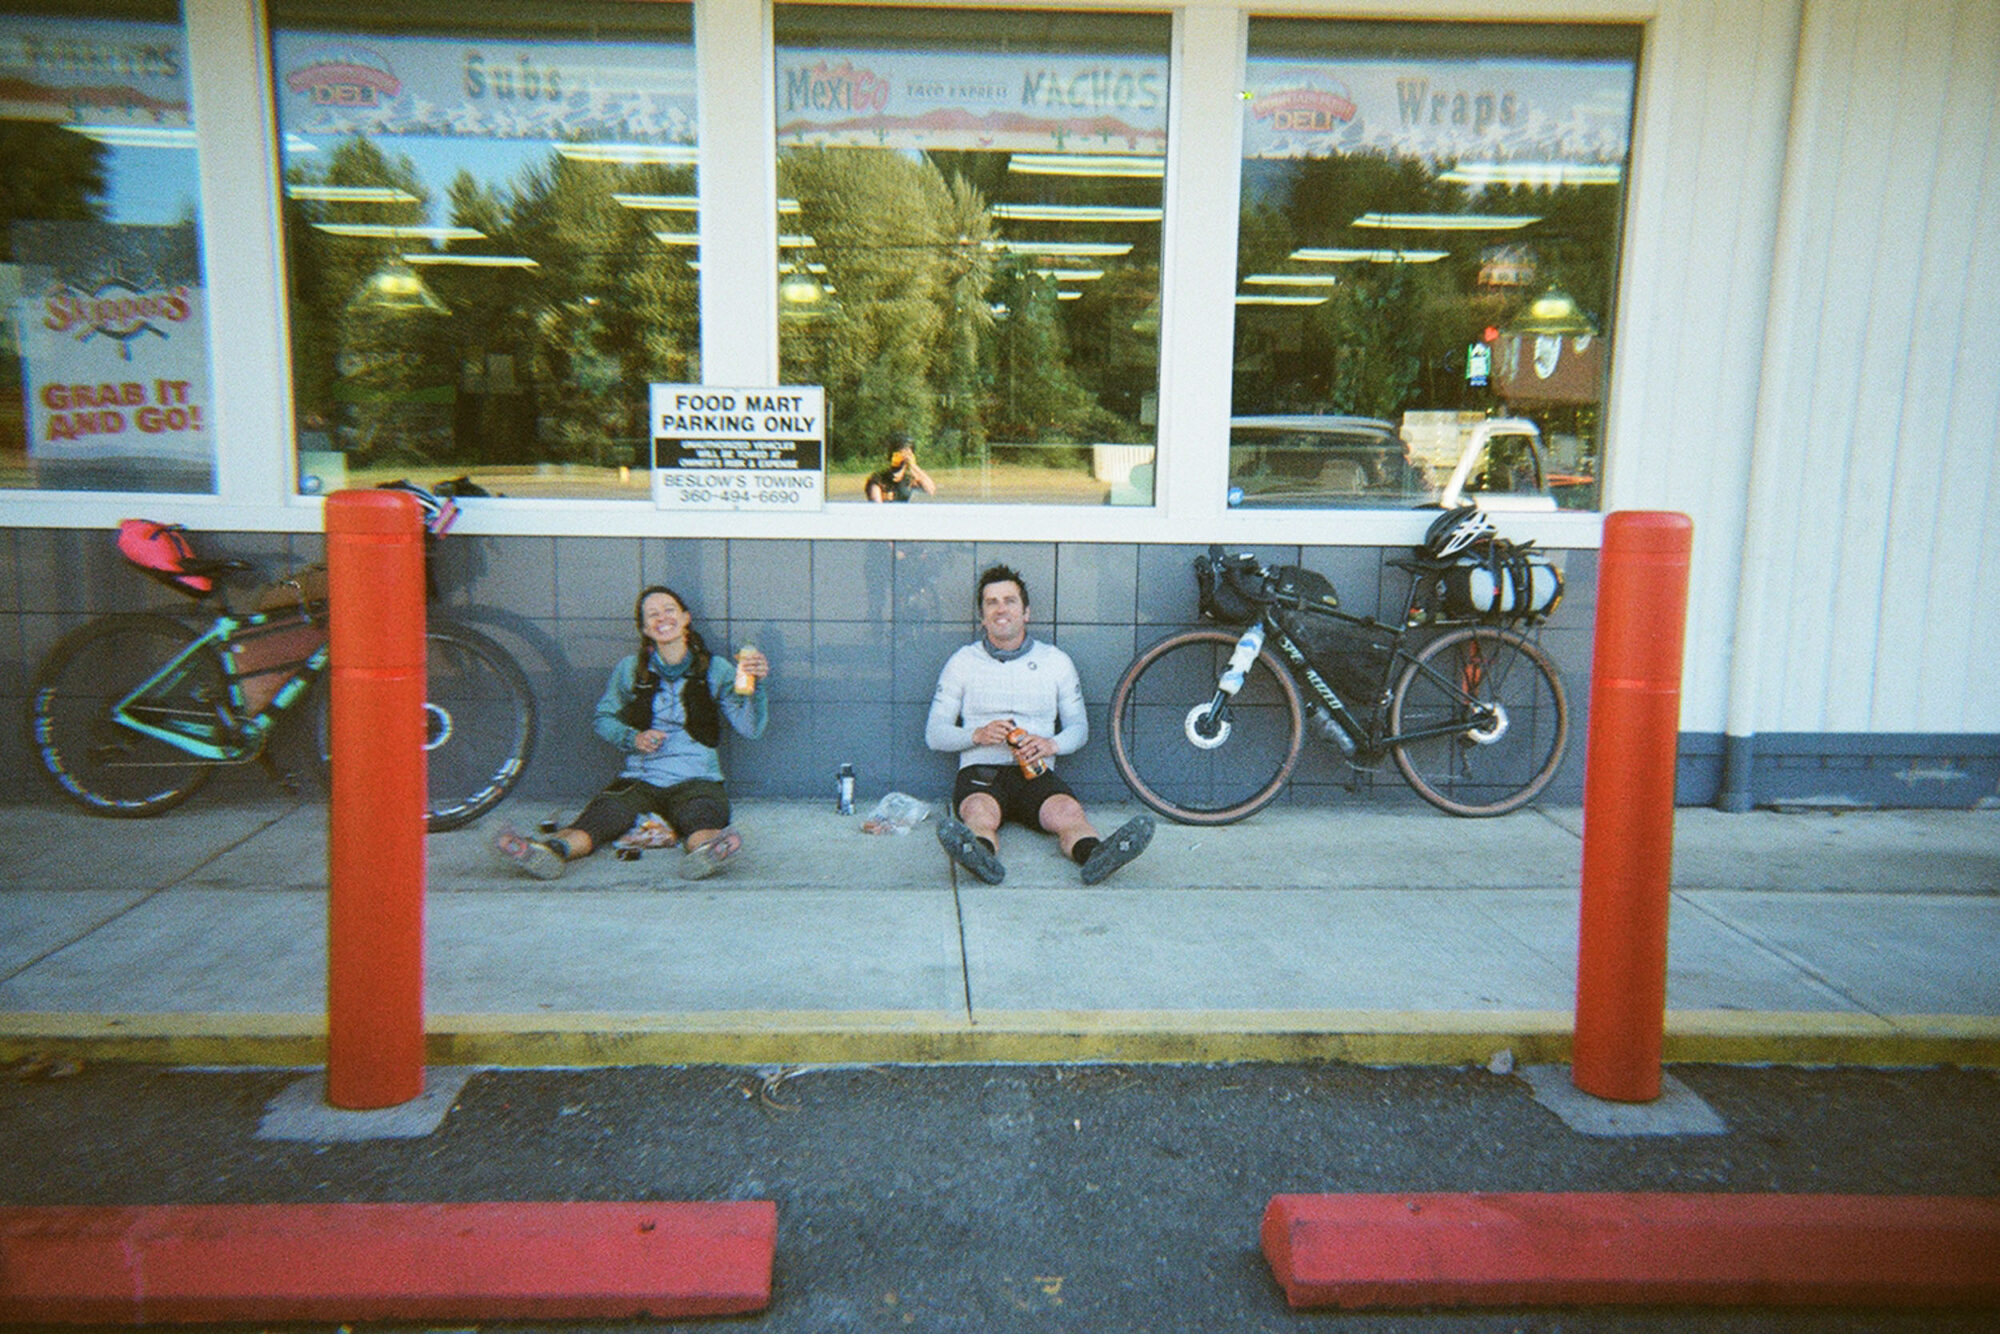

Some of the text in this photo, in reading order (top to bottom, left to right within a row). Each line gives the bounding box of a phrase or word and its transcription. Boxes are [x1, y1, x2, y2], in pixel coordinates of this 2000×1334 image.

[464, 48, 562, 101] Subs
[1021, 67, 1161, 110] NACHOS
[1395, 77, 1517, 135] Wraps
[1274, 111, 1333, 130] DELI
[40, 378, 192, 411] GRAB IT
[675, 395, 803, 412] FOOD MART
[45, 404, 204, 441] AND GO!
[662, 415, 815, 432] PARKING ONLY
[664, 475, 814, 488] BESLOW'S TOWING
[680, 489, 799, 503] 360-494-6690
